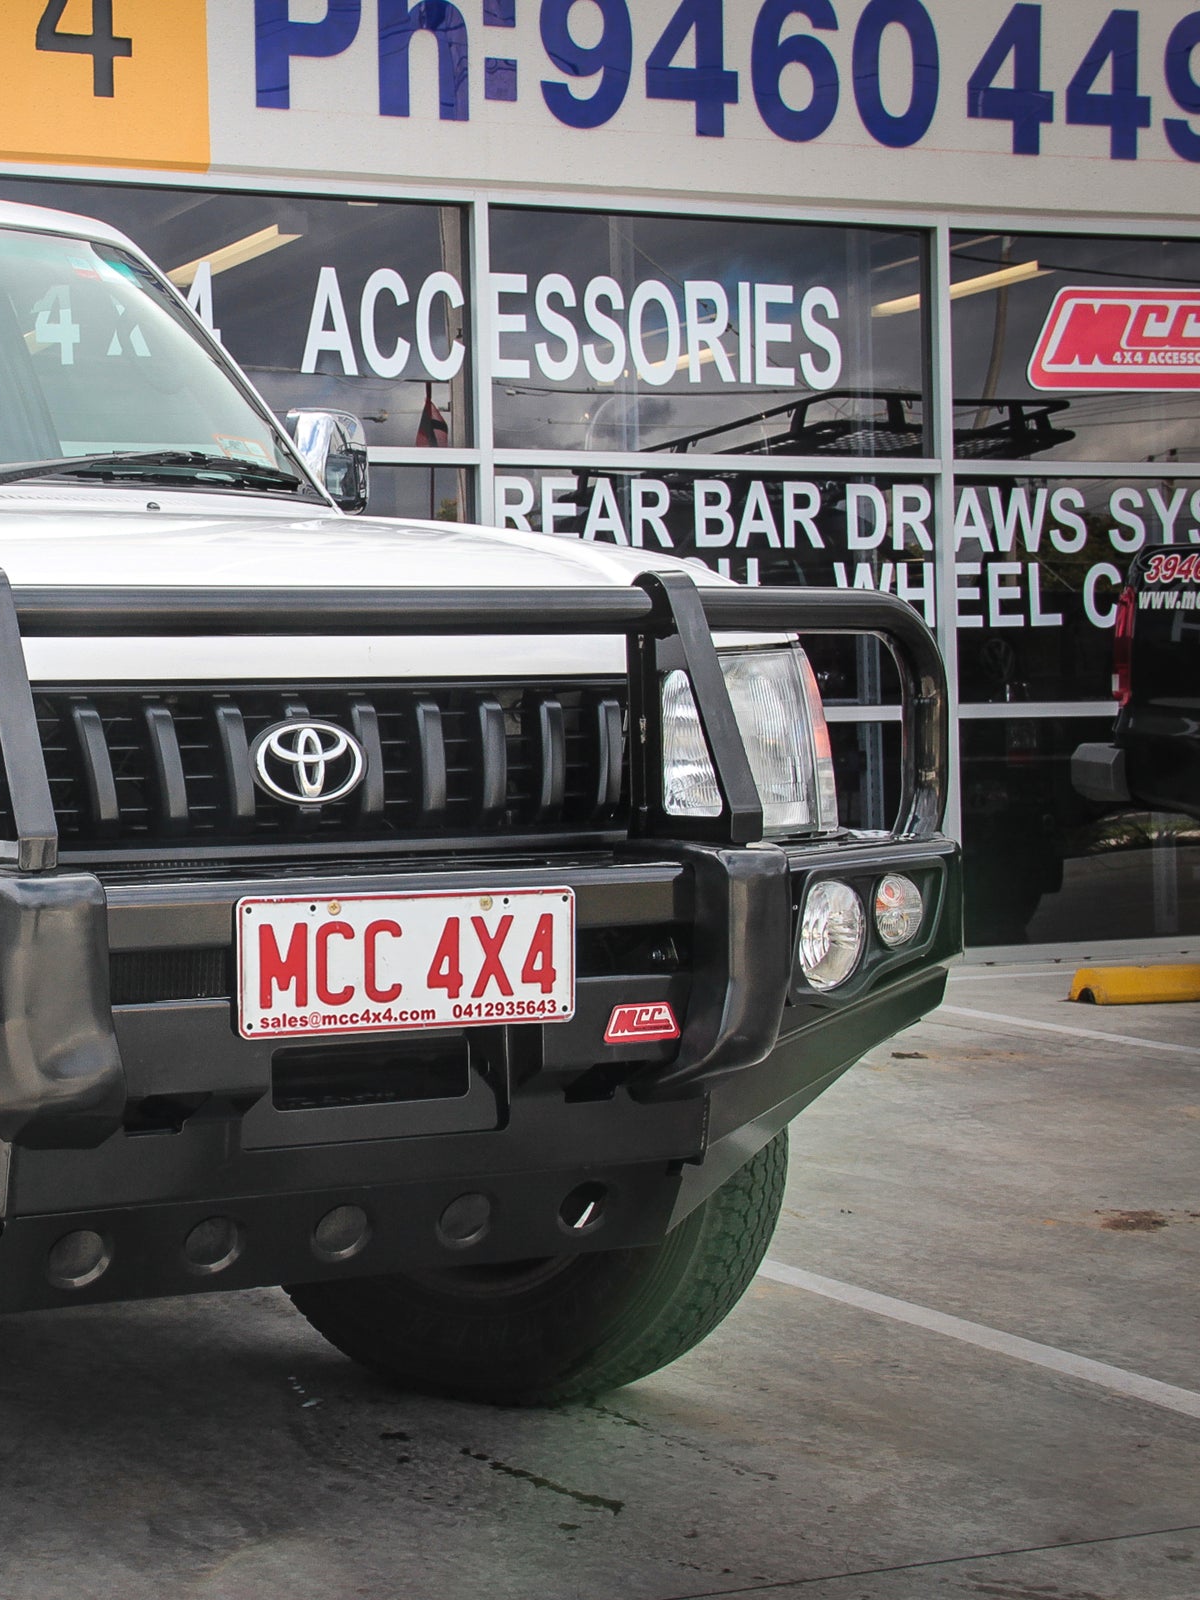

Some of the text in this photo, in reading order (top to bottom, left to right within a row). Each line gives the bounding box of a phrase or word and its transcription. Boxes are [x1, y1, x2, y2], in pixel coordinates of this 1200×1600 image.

[35, 0, 133, 98] 4
[301, 266, 842, 391] ACCESSORIES
[1112, 352, 1143, 364] 4X4
[494, 475, 675, 548] REAR
[694, 480, 825, 549] BAR
[846, 483, 1087, 554] DRAWS
[258, 912, 557, 1009] MCC 4X4
[260, 999, 558, 1030] sales@mcc4x4.com 0412935643
[610, 1007, 671, 1034] MCC
